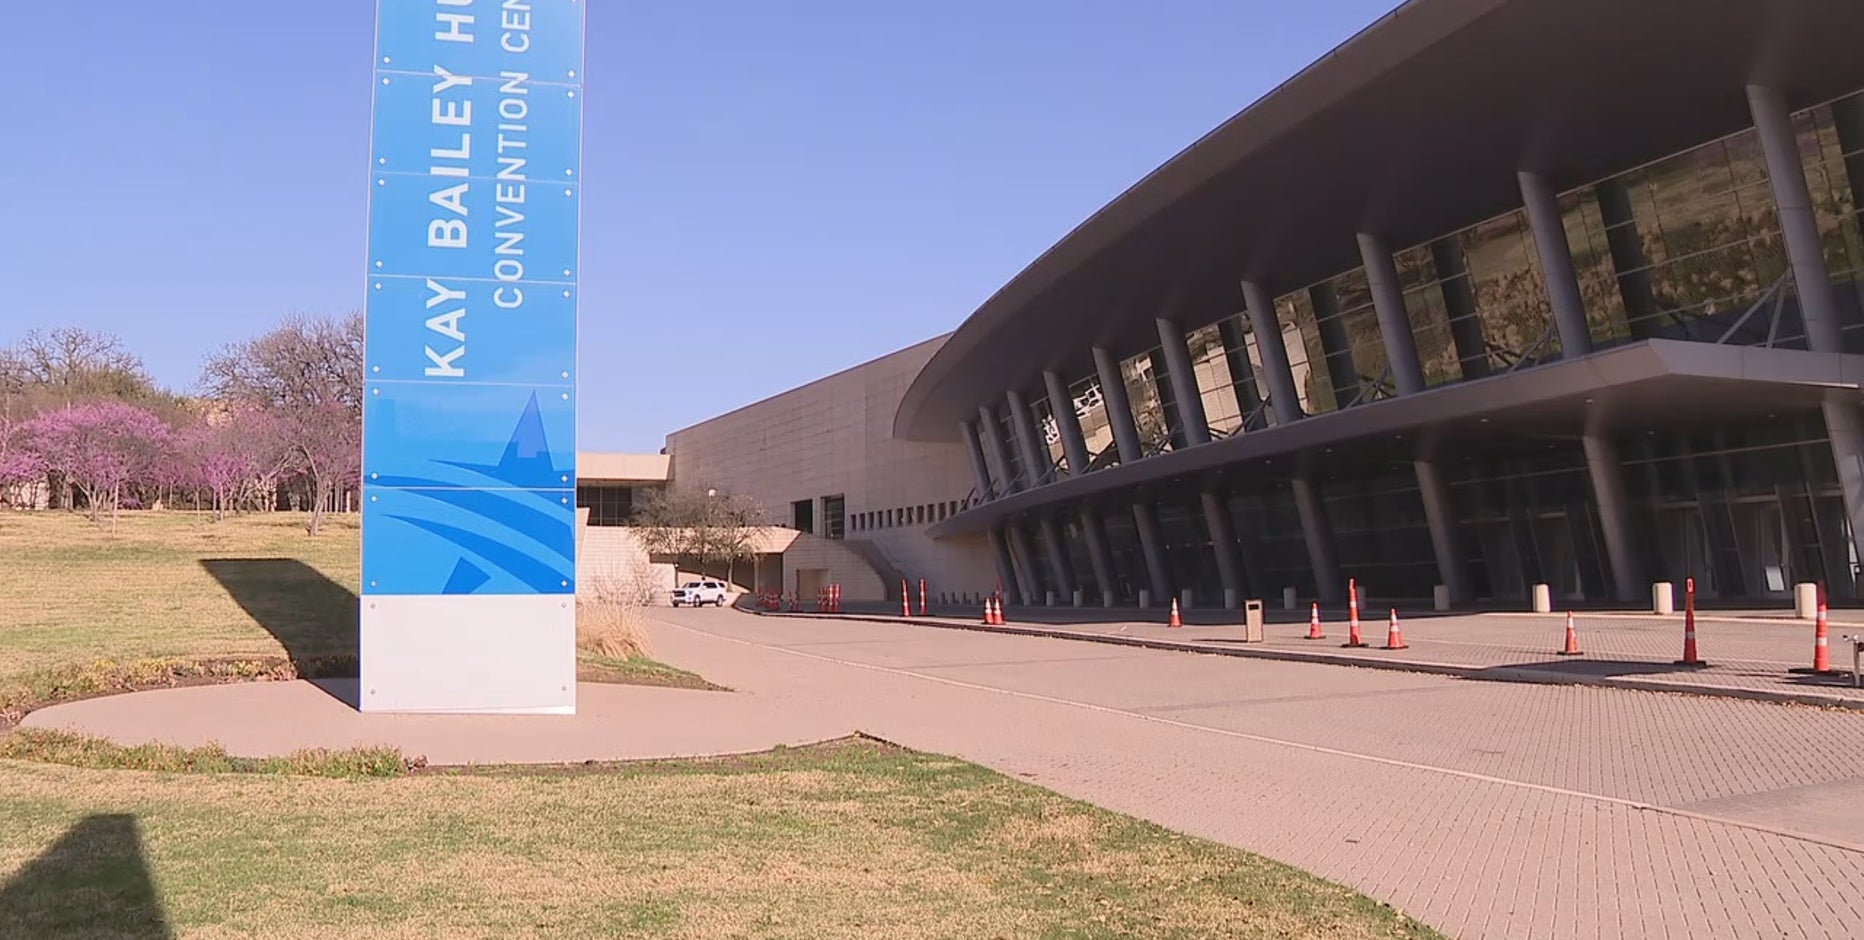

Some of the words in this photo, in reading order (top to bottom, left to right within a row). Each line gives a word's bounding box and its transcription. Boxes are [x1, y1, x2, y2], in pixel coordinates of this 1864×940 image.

[435, 0, 475, 43] H
[427, 64, 473, 249] BAILEY
[493, 71, 530, 309] CONVENTION
[424, 278, 467, 378] KAY
